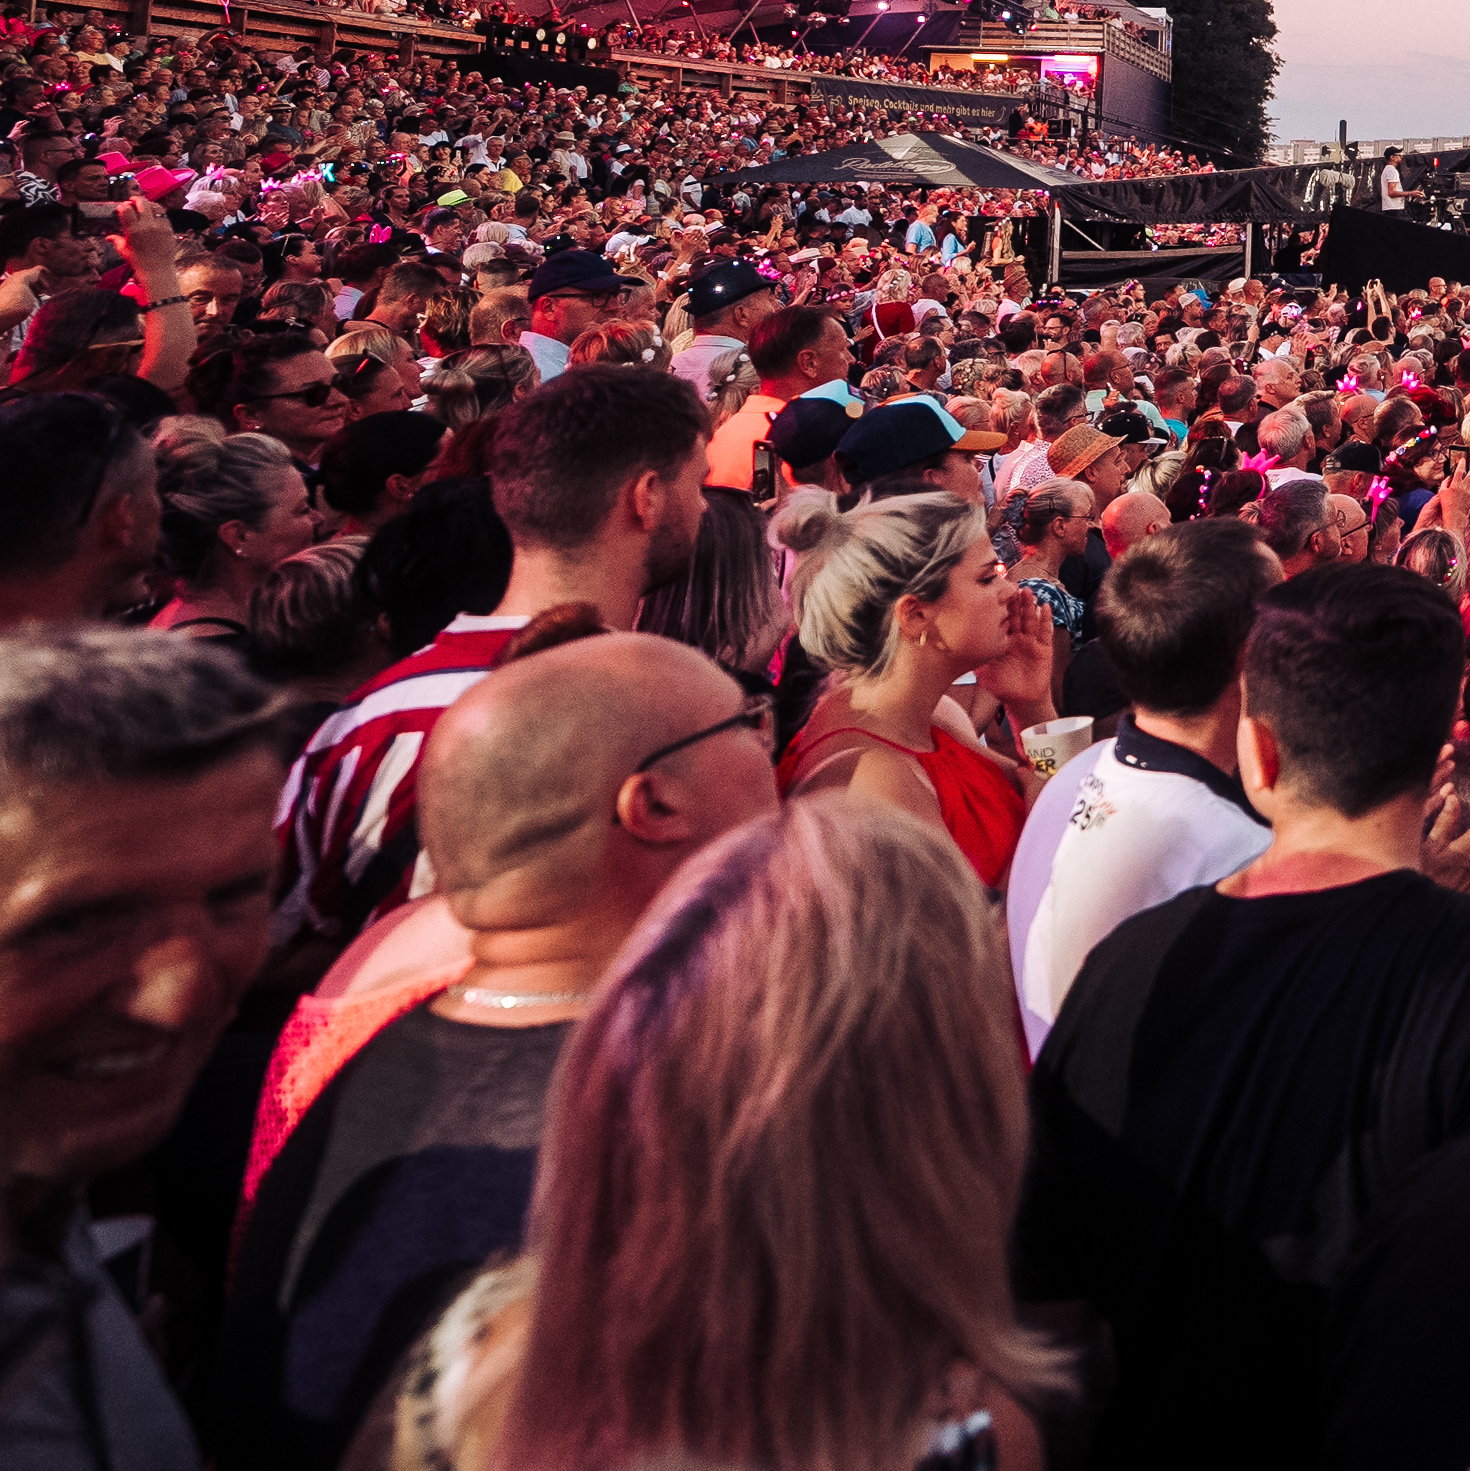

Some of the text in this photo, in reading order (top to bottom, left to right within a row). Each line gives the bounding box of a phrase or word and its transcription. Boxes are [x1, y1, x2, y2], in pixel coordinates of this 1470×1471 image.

[884, 98, 918, 110] Cocktails
[920, 103, 934, 112] und
[936, 105, 955, 114] mehr
[956, 105, 970, 117] gibt
[981, 107, 996, 117] hier
